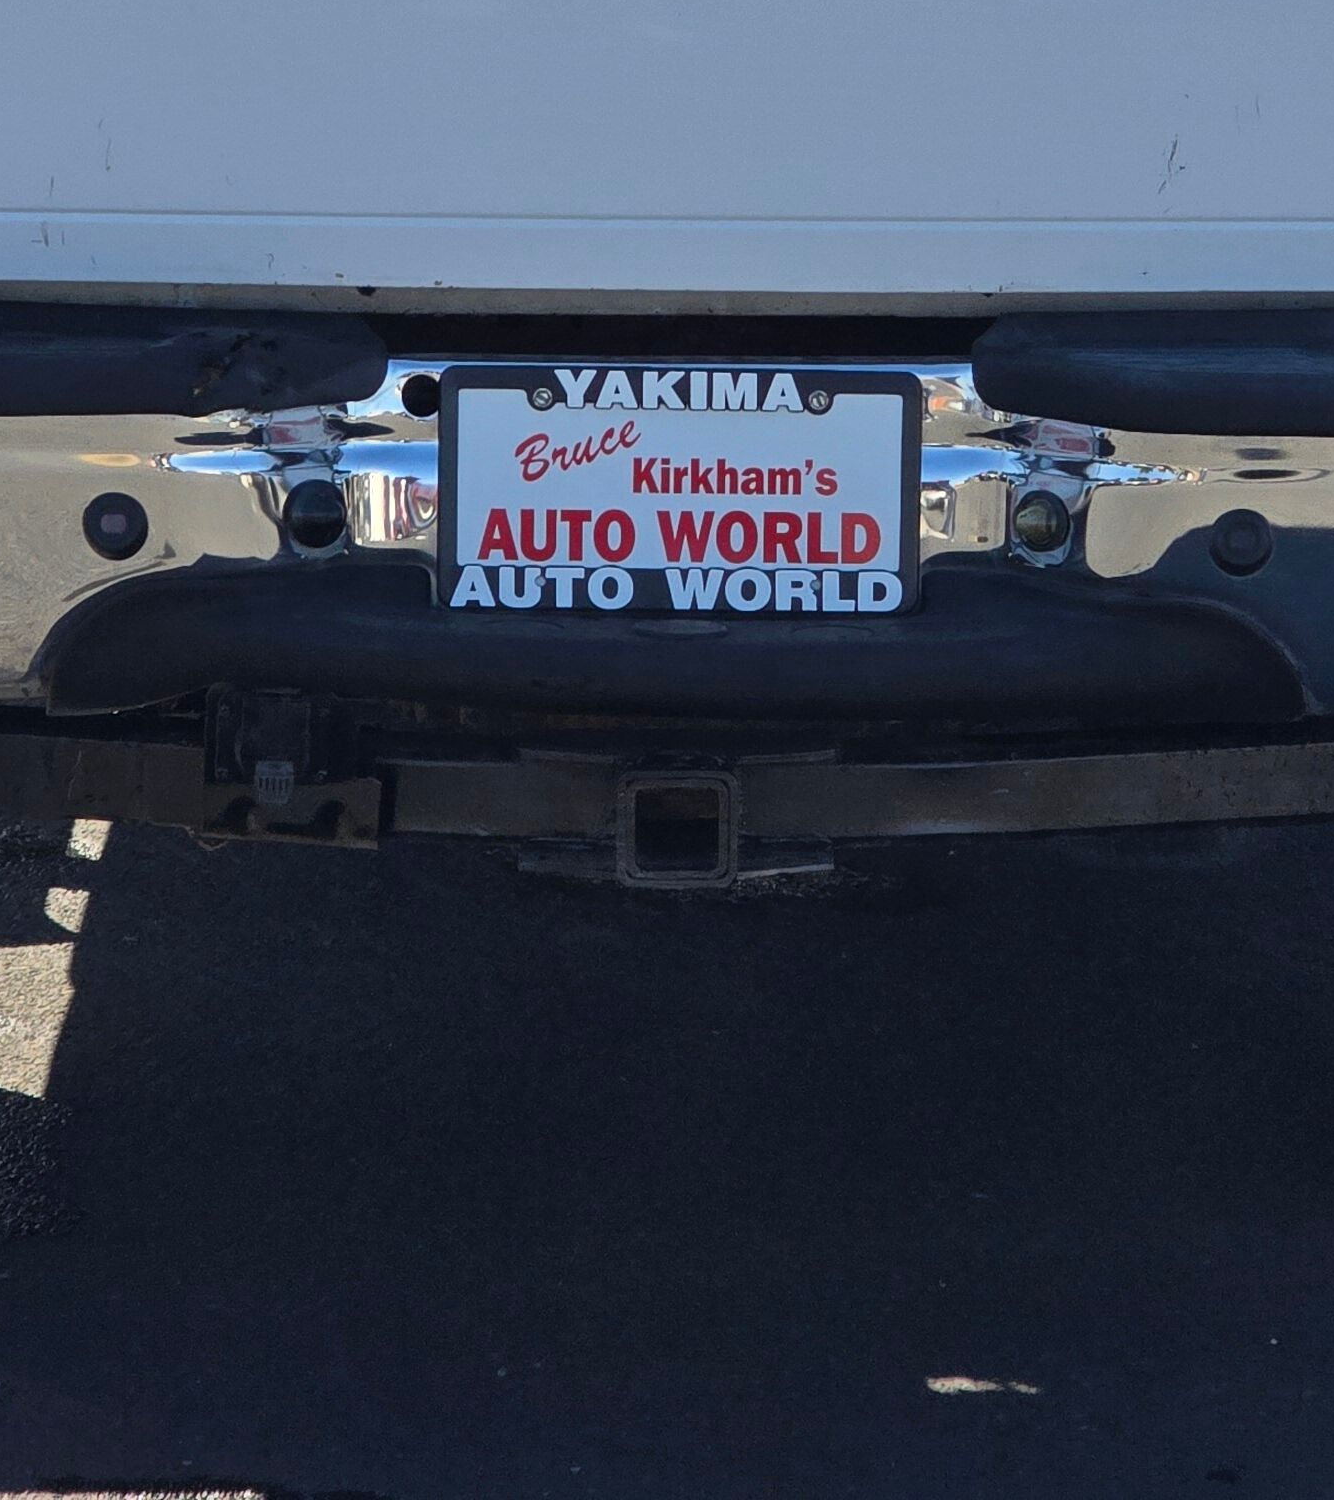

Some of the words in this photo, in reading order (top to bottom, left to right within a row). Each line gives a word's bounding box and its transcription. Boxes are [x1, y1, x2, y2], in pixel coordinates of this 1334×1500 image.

[554, 369, 805, 411] YAKIMA
[514, 420, 641, 482] Bruce
[632, 457, 838, 496] Kirkham's
[478, 508, 636, 562] AUTO
[657, 510, 881, 564] WORLD
[450, 565, 634, 610] AUTO
[665, 568, 903, 612] WORLD
